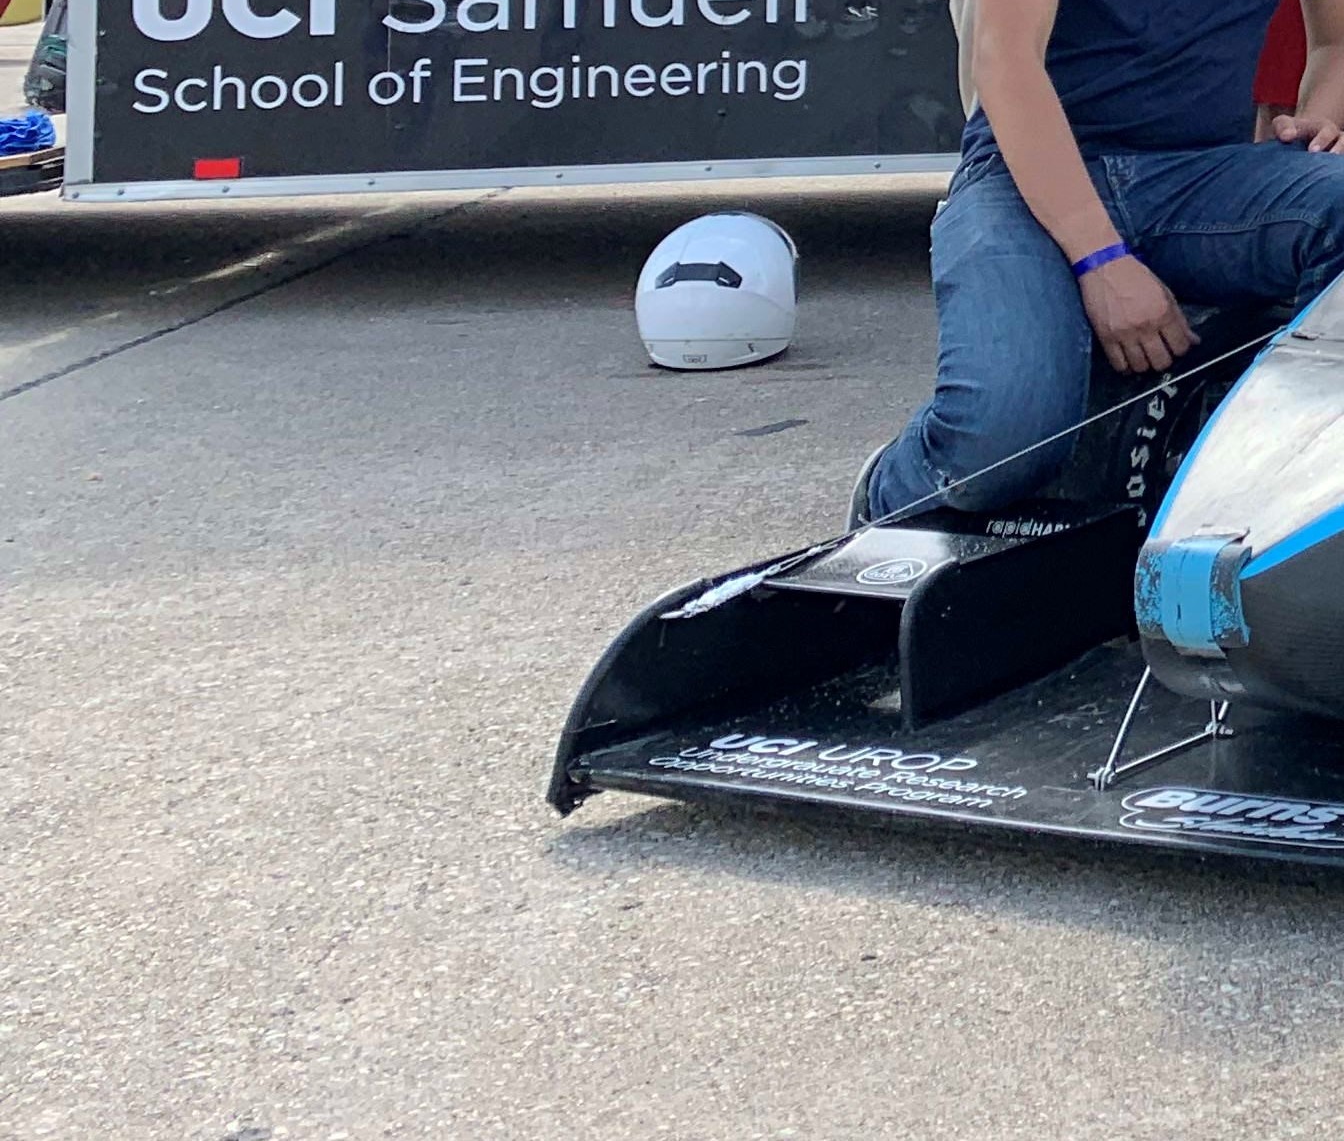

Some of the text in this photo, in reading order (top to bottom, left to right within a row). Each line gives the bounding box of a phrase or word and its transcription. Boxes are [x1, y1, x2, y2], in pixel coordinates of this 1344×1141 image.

[132, 50, 808, 113] School of Engineering
[709, 733, 979, 773] UCI UROP
[648, 756, 994, 809] Opportunities Program
[884, 771, 1029, 801] Research
